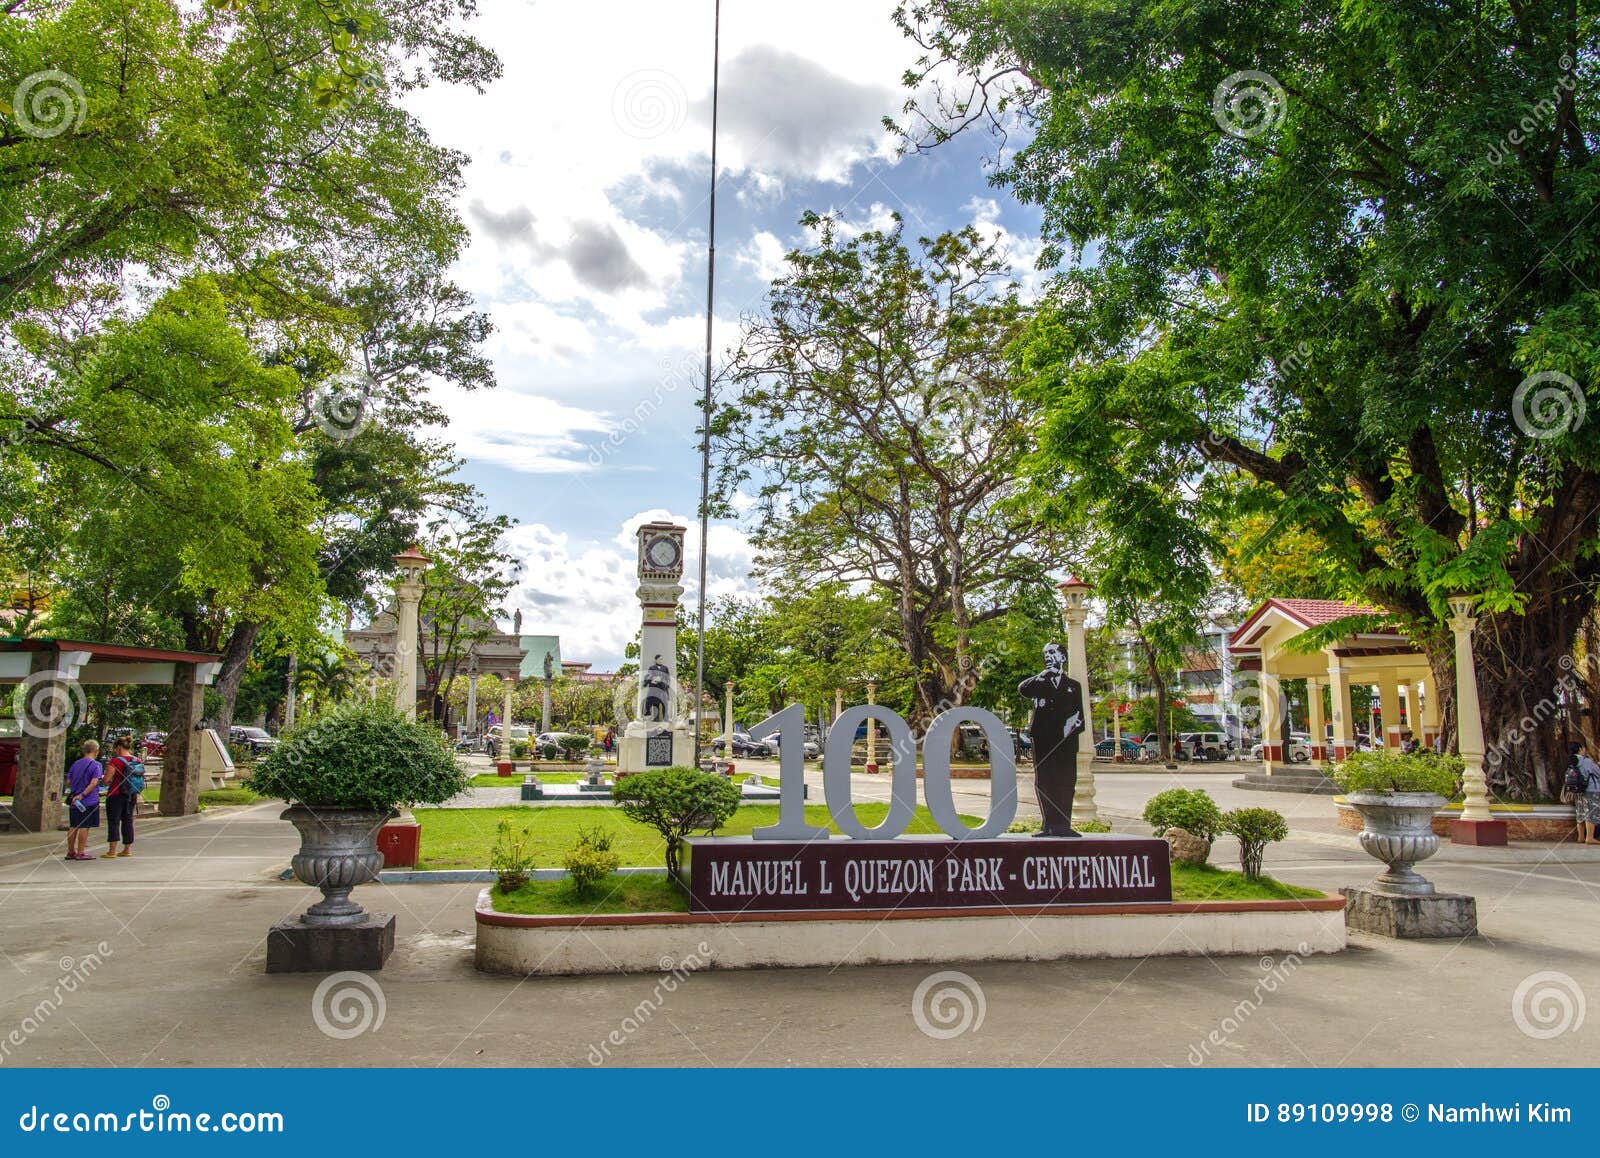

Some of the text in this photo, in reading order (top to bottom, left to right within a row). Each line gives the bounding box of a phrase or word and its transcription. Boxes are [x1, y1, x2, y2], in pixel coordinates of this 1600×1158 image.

[748, 702, 1017, 840] 100
[710, 860, 807, 895] MANUEL
[819, 860, 832, 894] L
[844, 859, 934, 902] QUEZON
[947, 857, 1005, 892] PARK
[1022, 855, 1156, 889] CENTENNIAL
